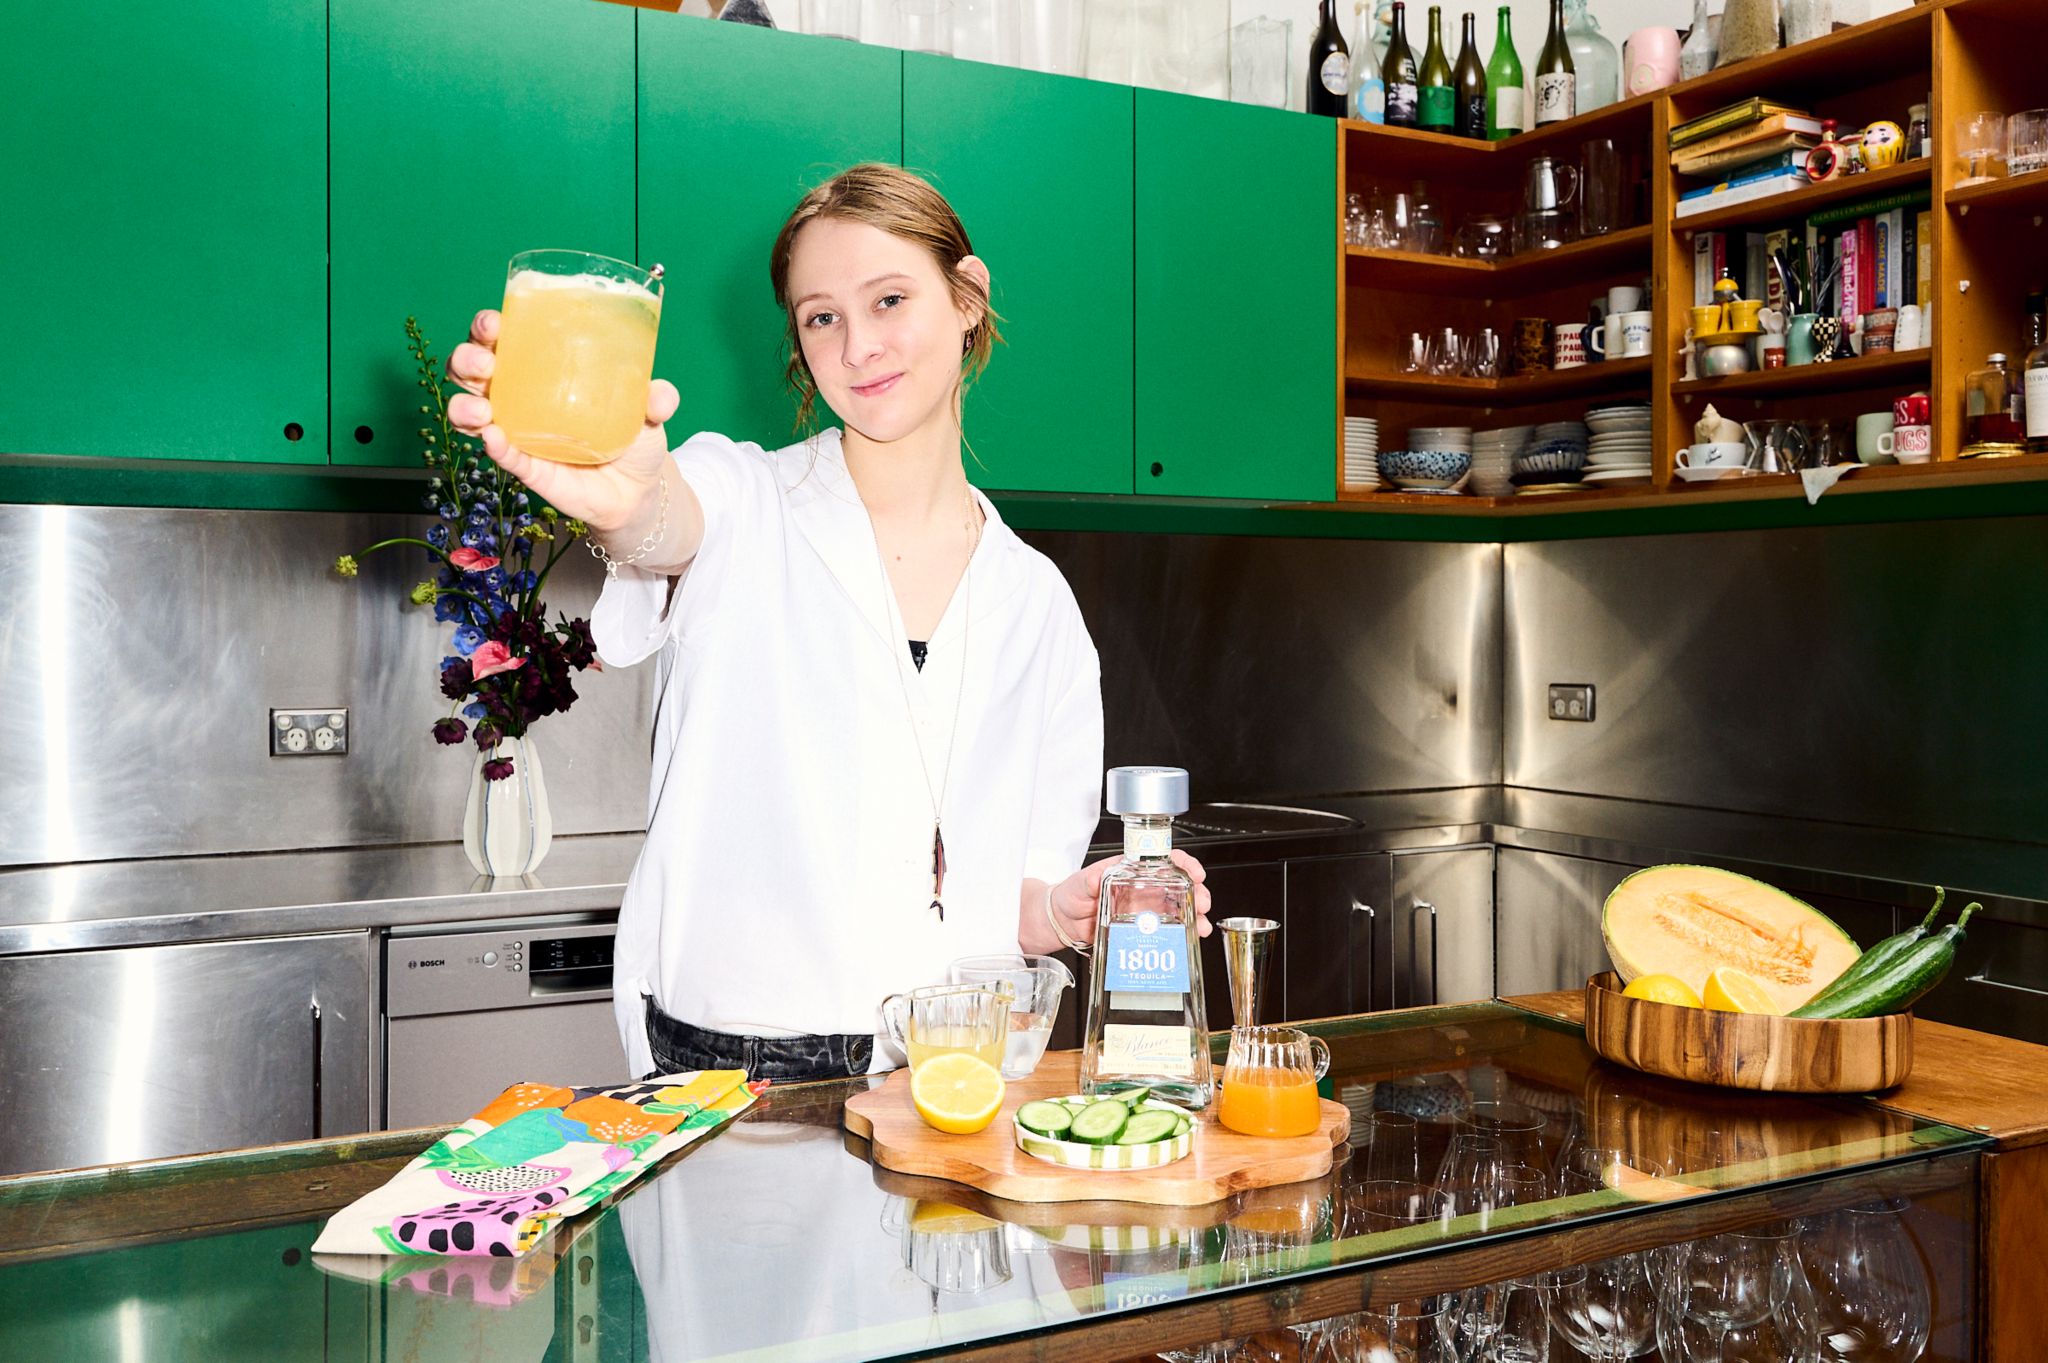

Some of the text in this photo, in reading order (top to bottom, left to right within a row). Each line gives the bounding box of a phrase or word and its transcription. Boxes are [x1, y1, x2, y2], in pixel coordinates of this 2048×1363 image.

[1877, 228, 1886, 293] HOME MADE
[1563, 332, 1581, 342] PAU
[420, 959, 445, 968] BOSCH
[1118, 949, 1176, 972] 1800
